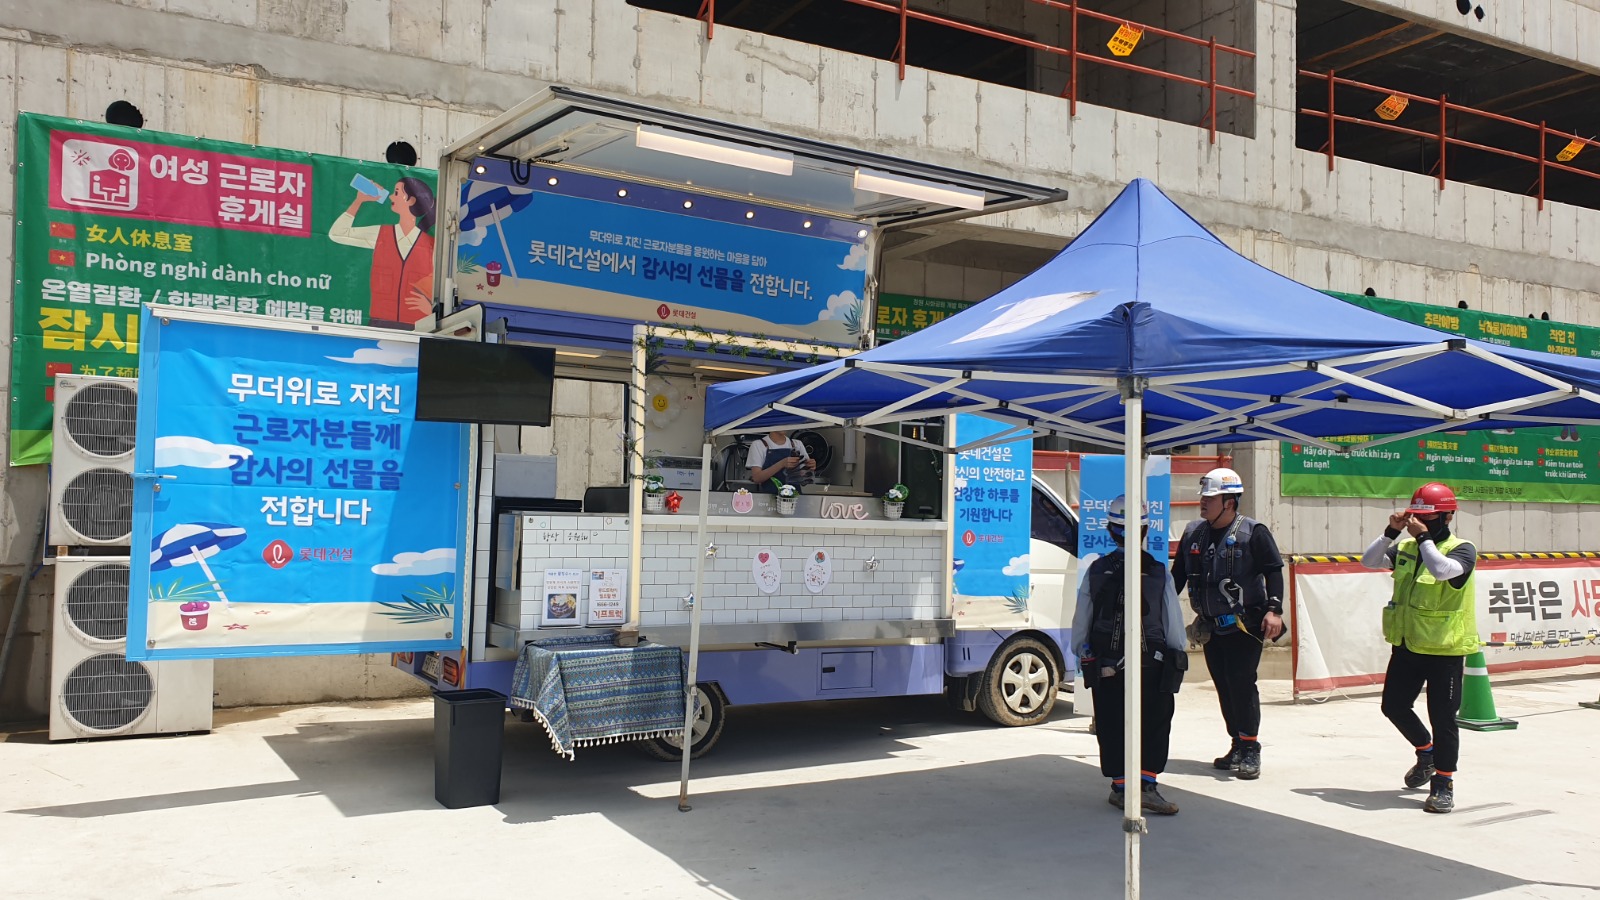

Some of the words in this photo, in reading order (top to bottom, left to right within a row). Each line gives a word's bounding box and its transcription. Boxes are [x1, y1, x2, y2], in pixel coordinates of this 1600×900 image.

[149, 152, 209, 185] 여성
[218, 161, 306, 198] 근로자
[217, 195, 304, 230] 휴게실
[85, 224, 194, 253] 女人休息室
[589, 230, 623, 245] 무더위로
[625, 236, 642, 249] 지친
[643, 238, 693, 257] 근로자분들을
[693, 246, 726, 262] 응원하는
[726, 251, 750, 266] 마음을
[751, 255, 767, 268] 담아
[86, 251, 157, 278] Phòng
[161, 260, 207, 281] nghỉ
[211, 262, 262, 284] dành
[266, 270, 302, 288] cho
[306, 273, 332, 291] nữ
[528, 239, 637, 276] 롯데건설에서
[641, 256, 693, 284] 감사의
[697, 265, 746, 293] 선물을
[750, 273, 813, 301] 전합니다.
[41, 278, 142, 308] 온열질환
[265, 299, 325, 323] 예방을
[329, 306, 362, 325] 위해
[672, 309, 697, 320] 롯데건설
[38, 306, 139, 355] 잠시
[912, 308, 954, 329] 휴게
[1424, 312, 1460, 331] 추락예방
[1549, 328, 1566, 344] 작업
[1567, 331, 1576, 345] 전
[227, 372, 342, 407] 무더위로
[349, 382, 401, 414] 지친
[232, 413, 402, 451] 근로자분들께
[227, 453, 313, 486] 감사의
[322, 458, 404, 491] 선물을
[983, 467, 1026, 482] 안전하고
[1303, 460, 1313, 468] tai
[819, 496, 869, 520] love
[954, 486, 985, 502] 건강한
[987, 487, 1020, 504] 하루를
[260, 495, 372, 527] 전합니다
[959, 507, 1013, 523] 기원합니다
[299, 547, 353, 562] 롯데건설
[593, 609, 623, 619] 기프트럭
[1488, 580, 1563, 623] 추락은
